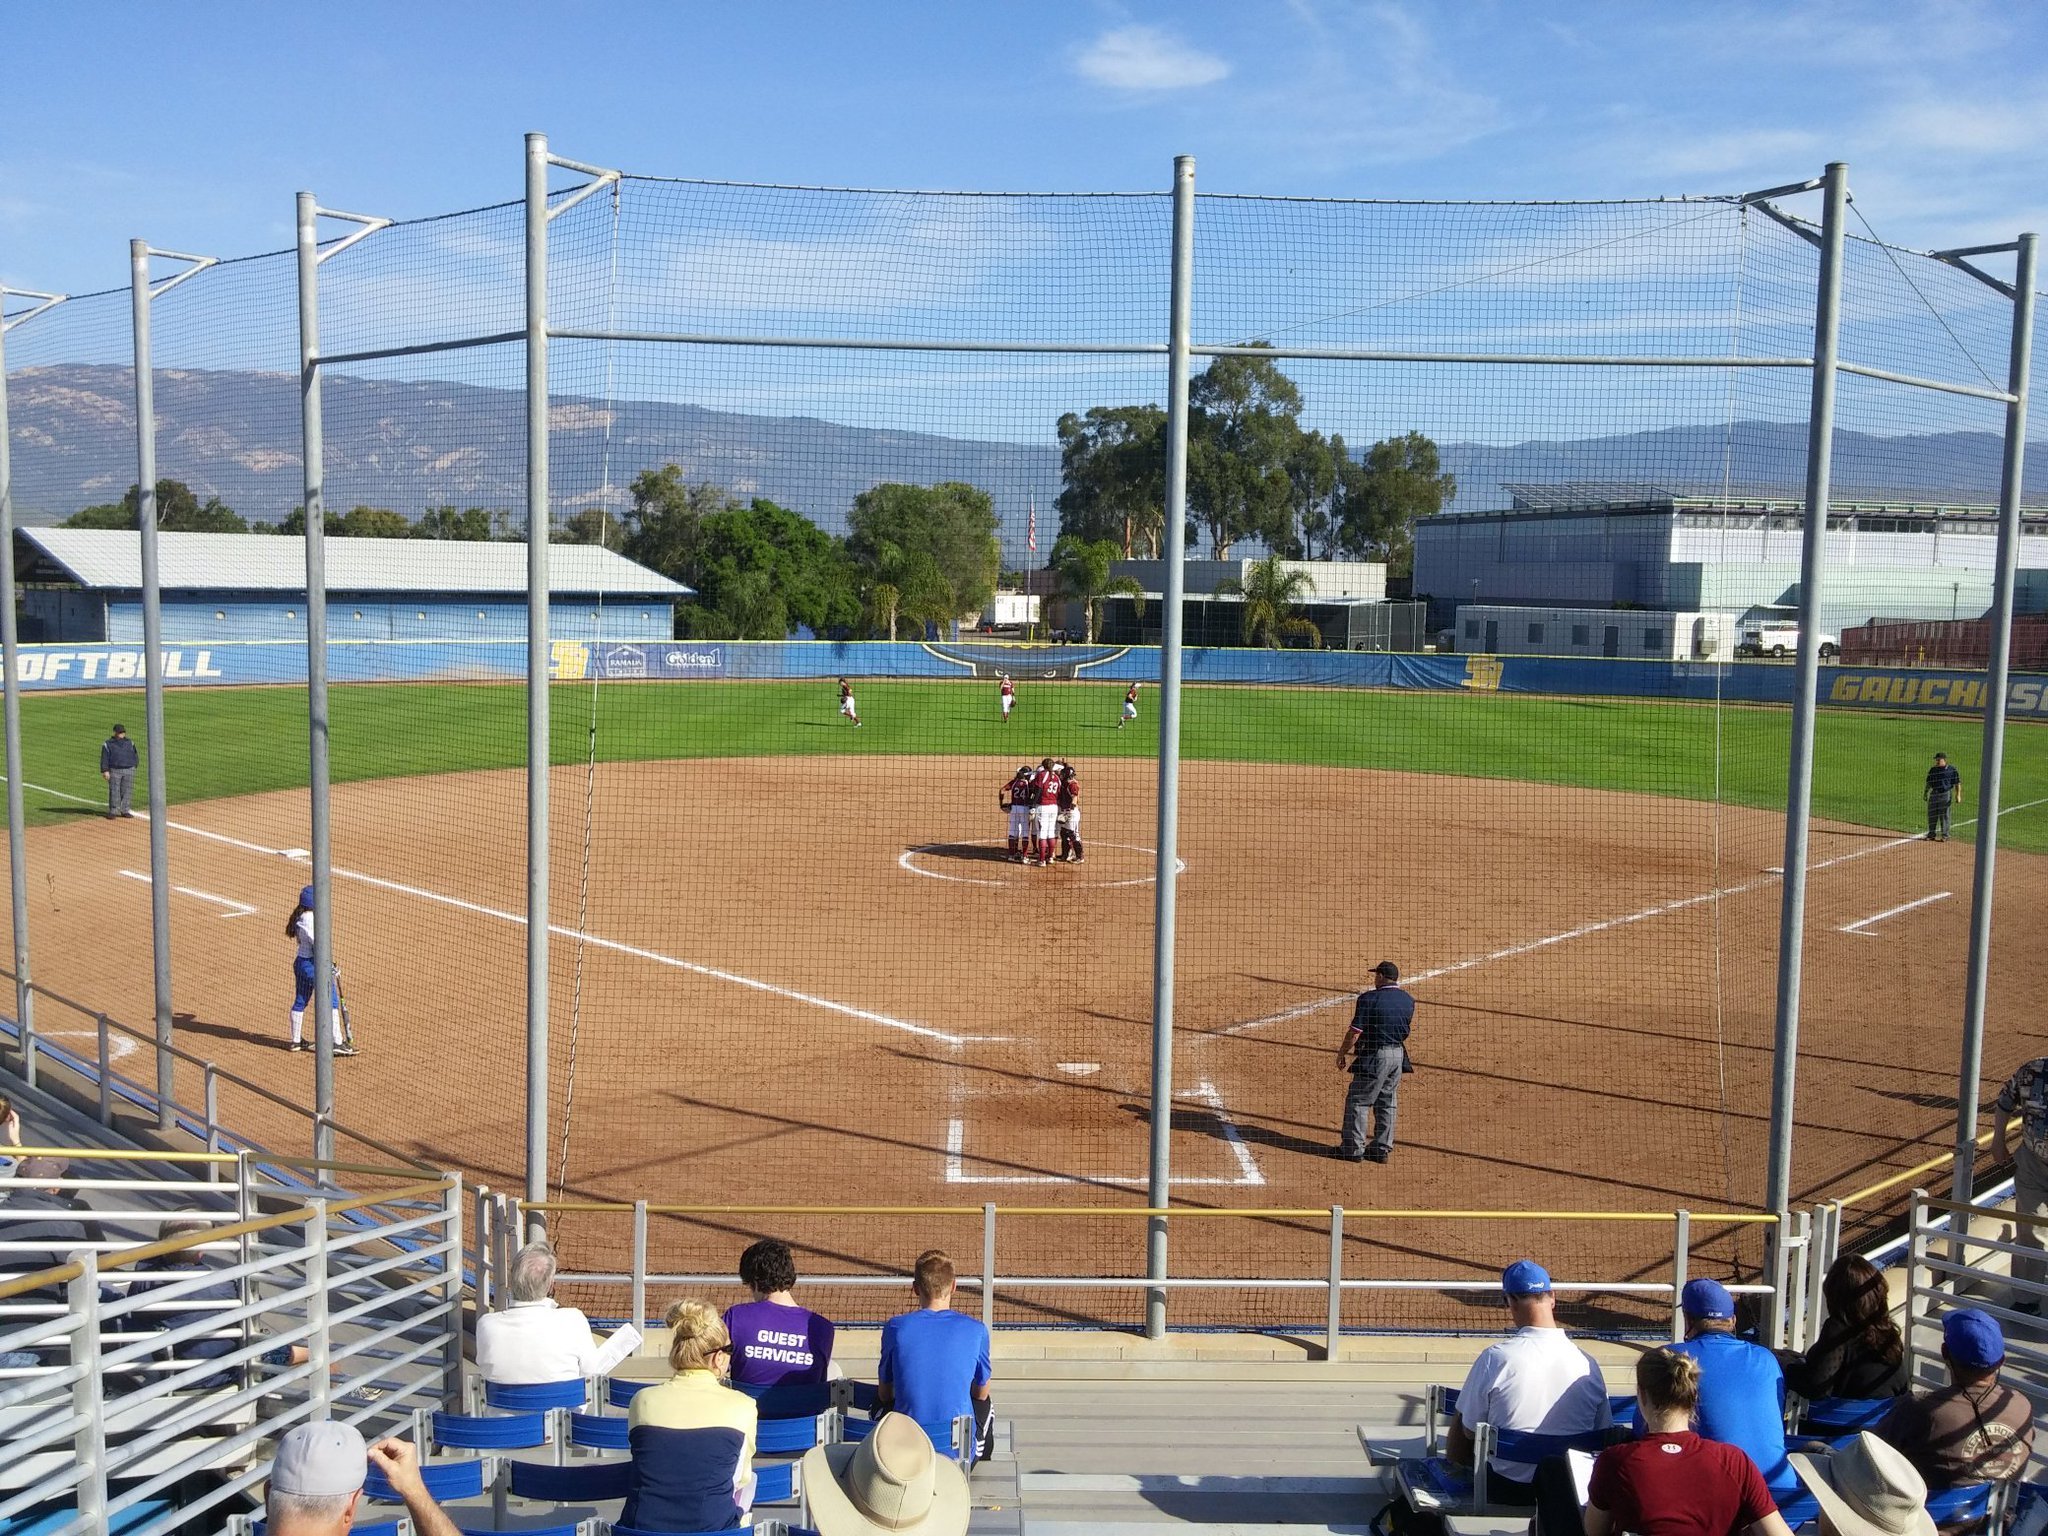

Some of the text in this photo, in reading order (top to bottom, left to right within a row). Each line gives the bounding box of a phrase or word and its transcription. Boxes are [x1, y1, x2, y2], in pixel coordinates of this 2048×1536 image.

[0, 651, 221, 681] OFTBLL
[1013, 787, 1026, 799] 24
[1047, 782, 1058, 794] 33
[757, 1329, 807, 1348] GUEST
[744, 1345, 814, 1366] SERVICES
